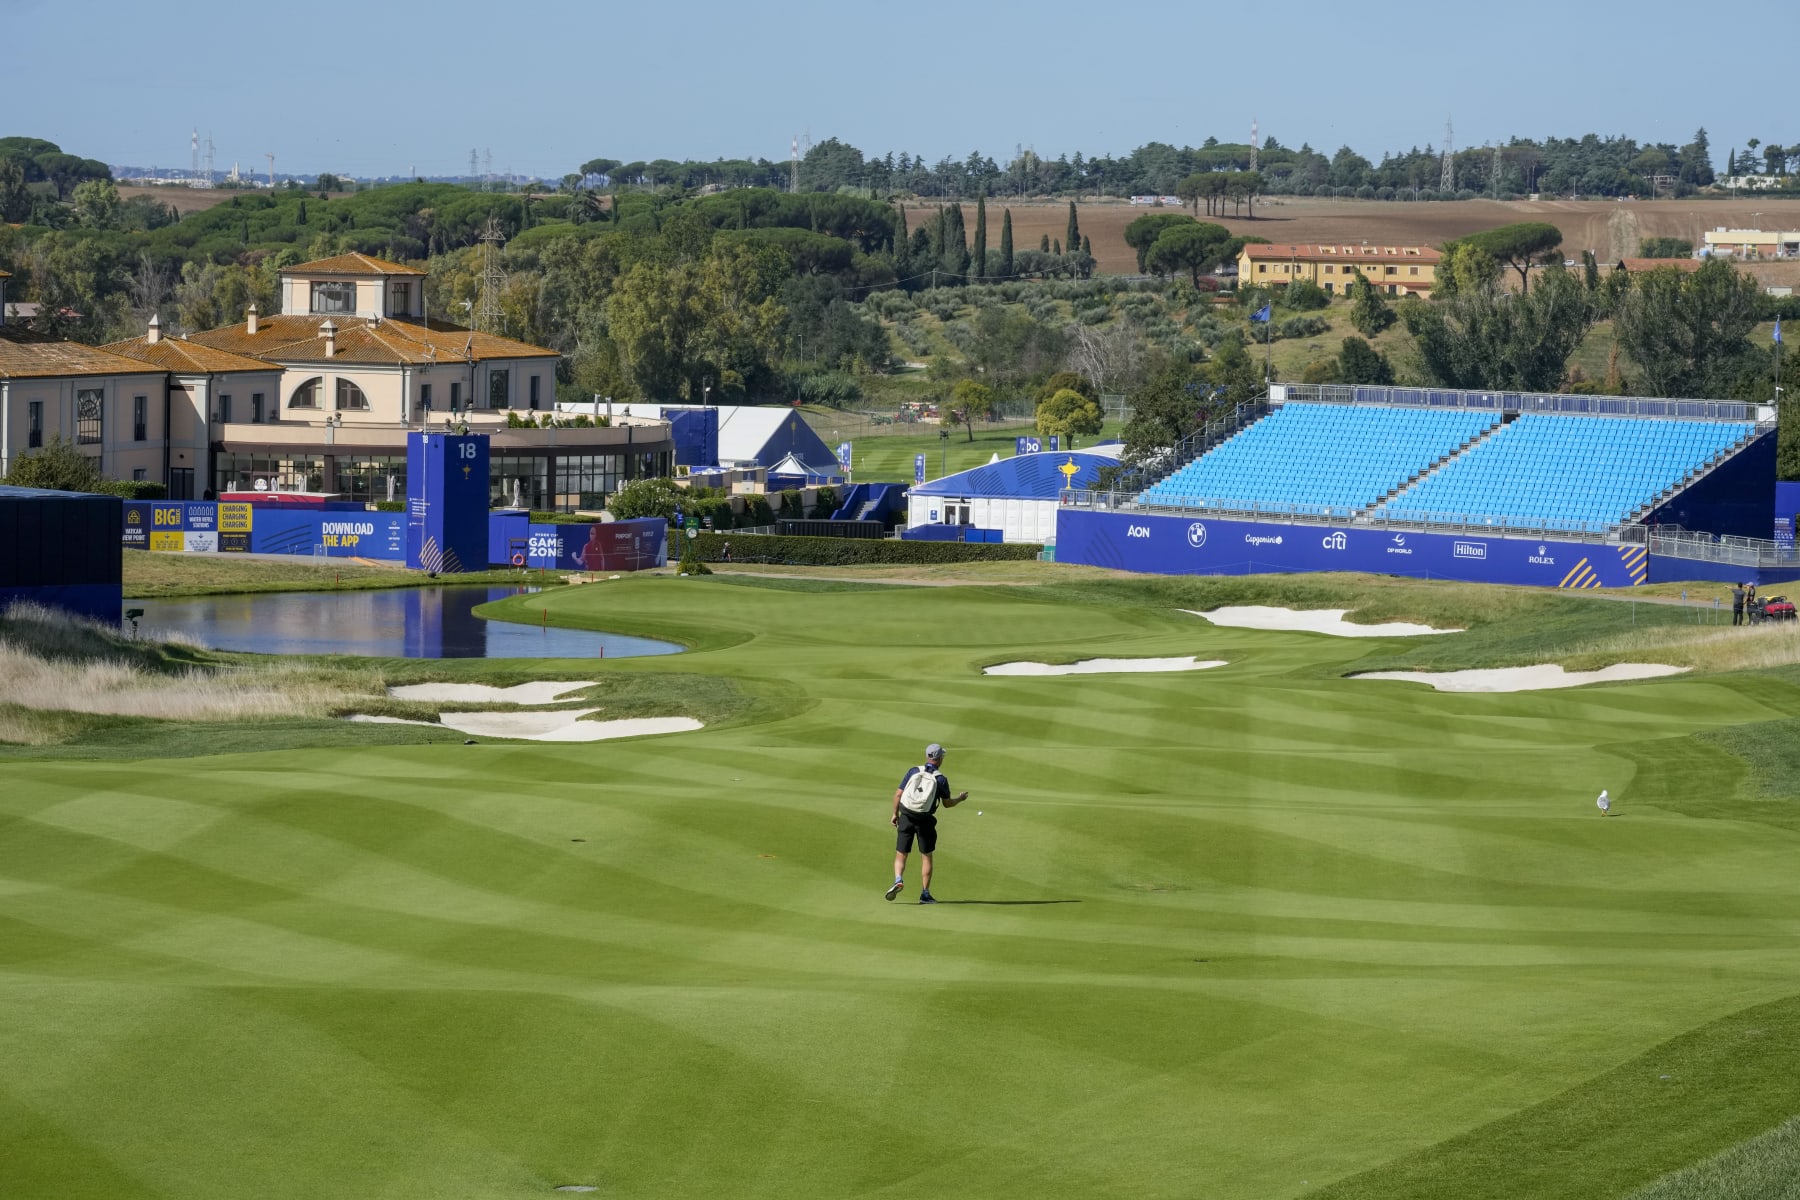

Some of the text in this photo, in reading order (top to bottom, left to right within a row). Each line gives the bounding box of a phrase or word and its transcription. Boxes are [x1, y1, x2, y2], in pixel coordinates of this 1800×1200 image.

[458, 442, 477, 459] 18
[154, 508, 175, 526] BIG
[322, 522, 374, 535] DOWNLOAD
[1127, 524, 1150, 538] AON
[322, 535, 360, 547] THE APP
[529, 537, 564, 548] GAME
[1322, 531, 1347, 550] citi
[529, 548, 564, 558] ZONE
[1456, 544, 1484, 557] Hilton
[1529, 556, 1555, 565] ROLEX
